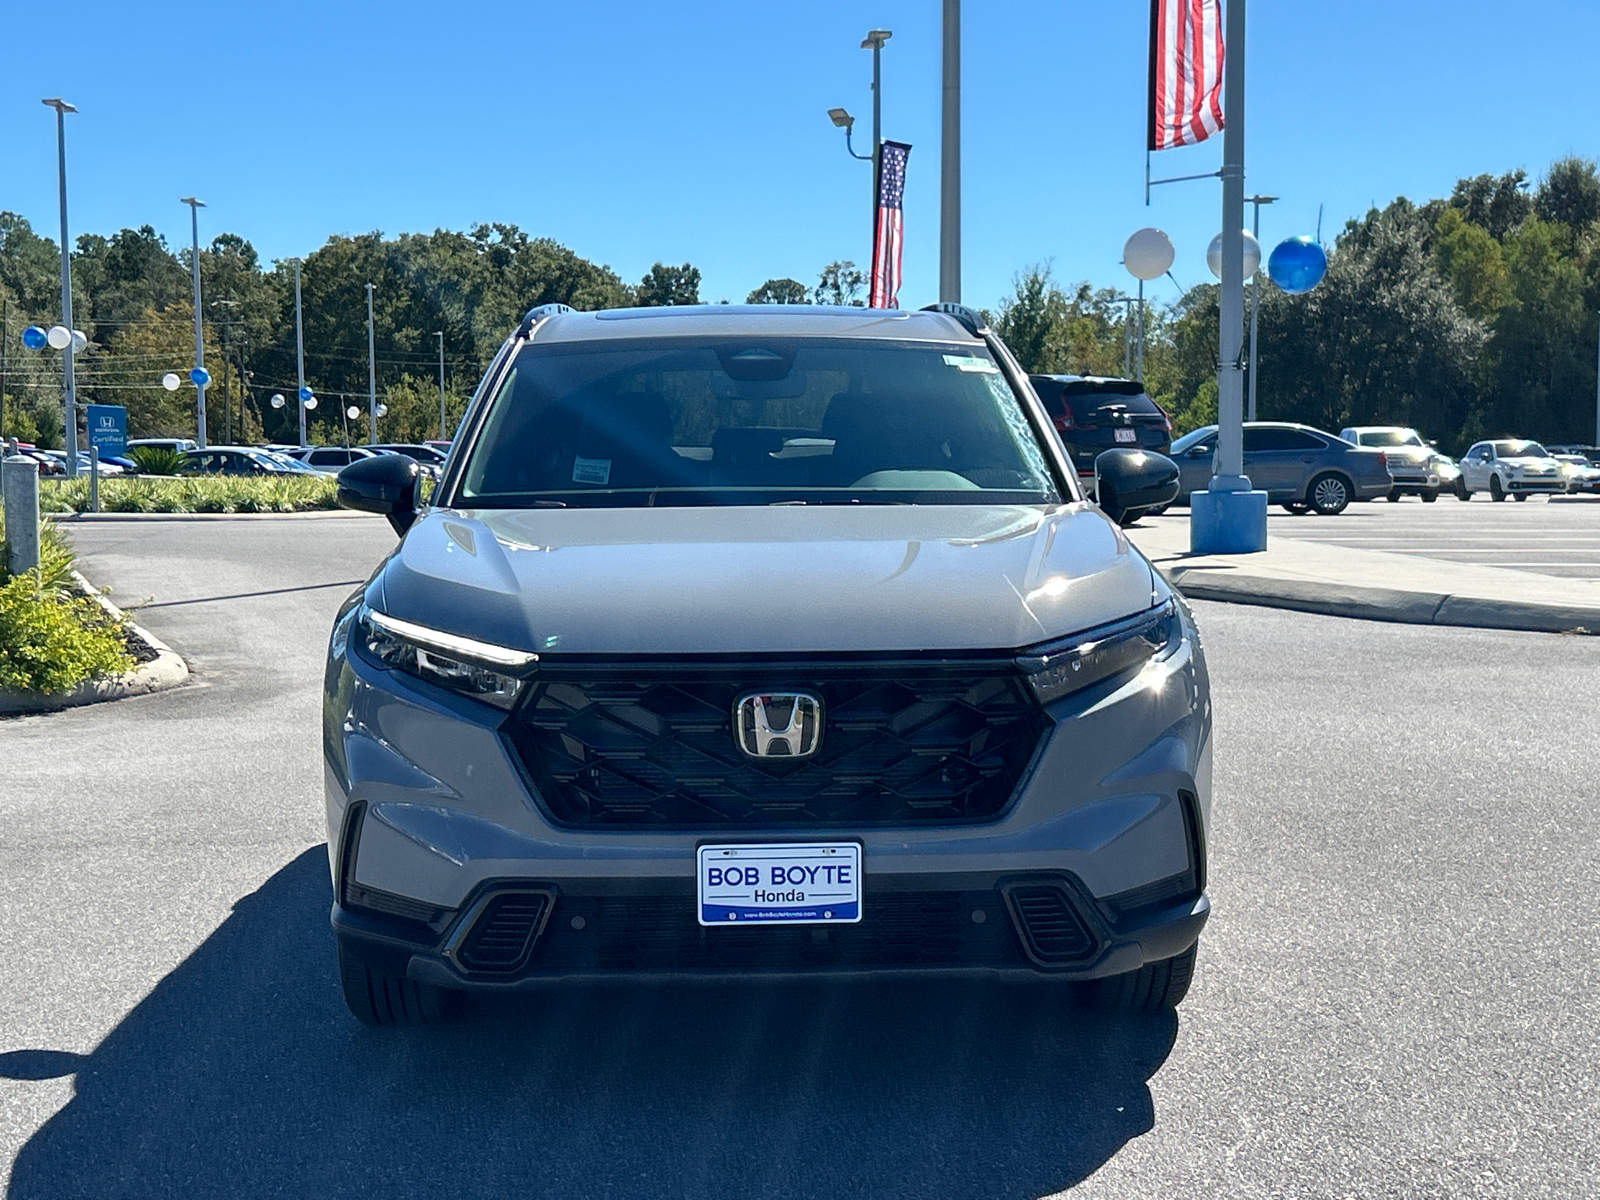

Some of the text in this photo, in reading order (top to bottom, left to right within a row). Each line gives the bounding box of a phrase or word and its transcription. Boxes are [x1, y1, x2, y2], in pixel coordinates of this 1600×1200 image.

[92, 435, 124, 443] Certified
[708, 865, 852, 886] BOB BOYTE
[754, 889, 805, 903] Honda
